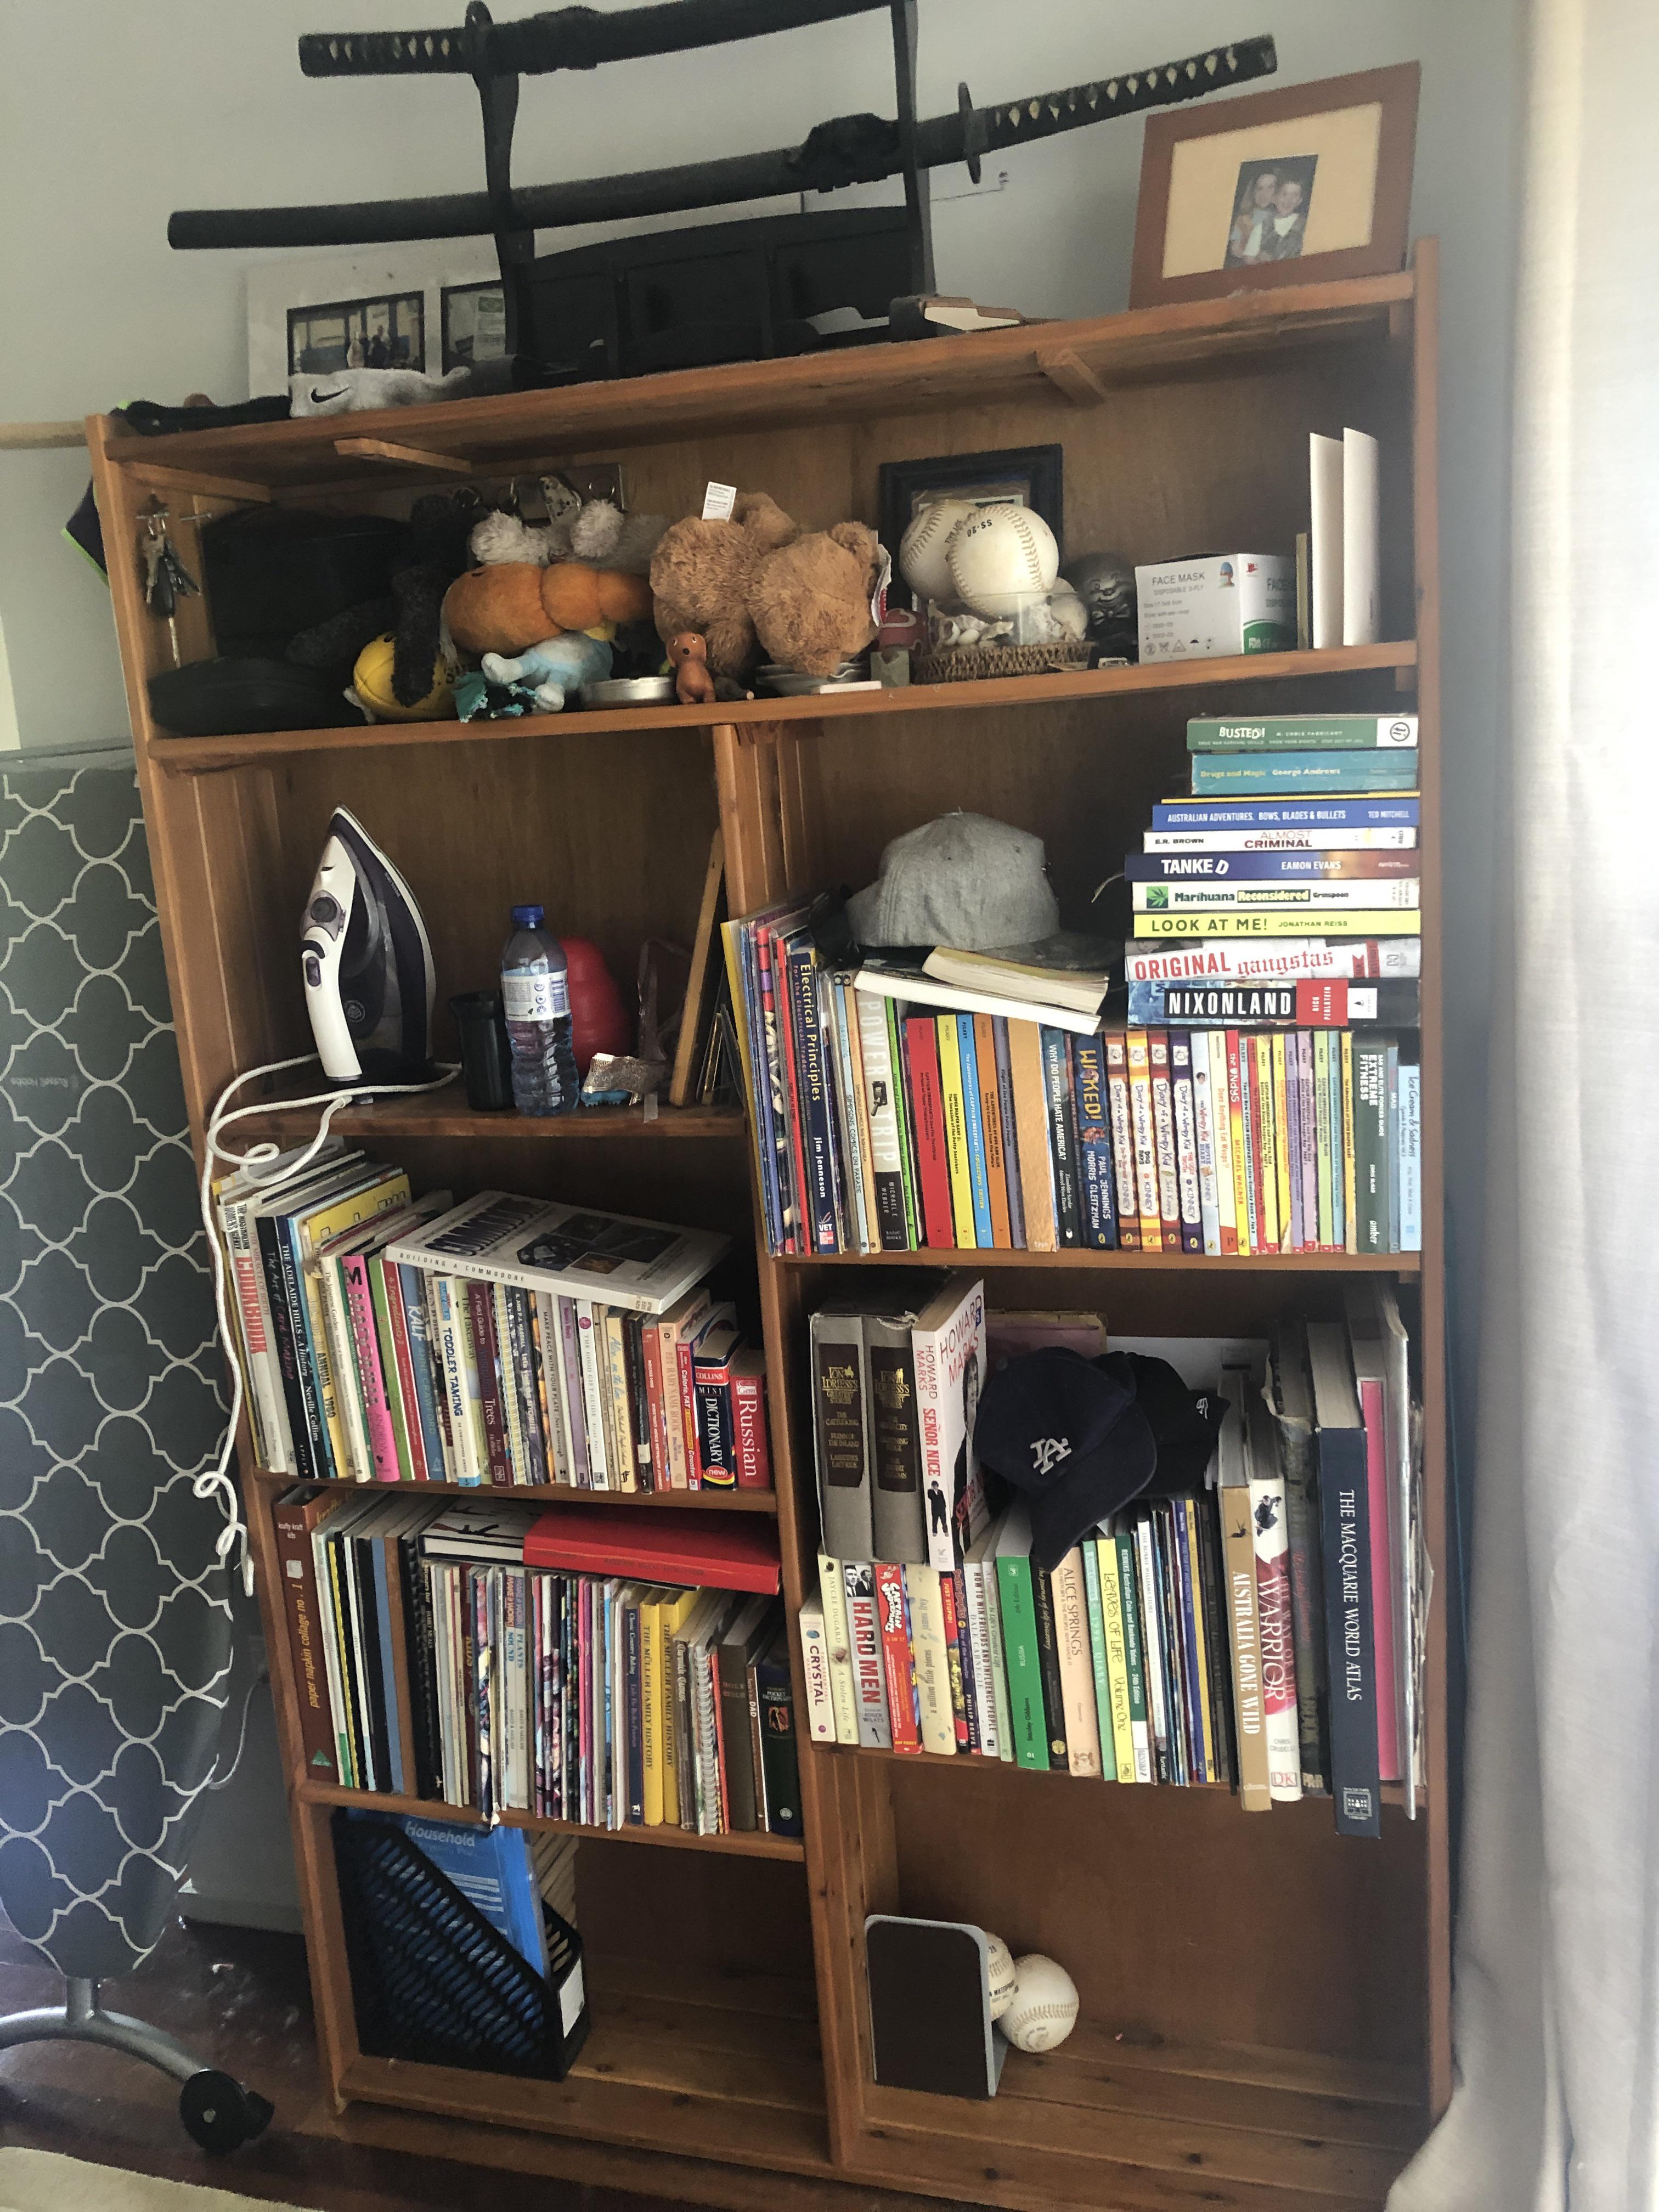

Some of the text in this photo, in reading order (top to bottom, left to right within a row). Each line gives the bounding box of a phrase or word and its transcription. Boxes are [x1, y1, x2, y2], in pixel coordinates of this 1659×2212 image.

[1153, 572, 1205, 585] FACE MASK
[1219, 726, 1265, 739] BUSTED!
[1244, 838, 1312, 849] CRIMINAL
[1260, 830, 1312, 840] ALMOST
[1282, 861, 1311, 870] EAMON
[1313, 860, 1341, 870] EVANS
[1175, 891, 1235, 902] Marihuana
[1238, 890, 1309, 901] Reconsidered
[1152, 919, 1200, 932] LOOK
[1207, 919, 1228, 931] AT
[1237, 919, 1267, 930] ME!
[1135, 952, 1231, 980] ORIGINAL
[1238, 950, 1334, 978] gangstas
[1169, 991, 1291, 1015] NIXONLAND
[800, 964, 826, 1198] Electrical Principles Jim Jenneson
[859, 1000, 896, 1163] POWER TRIP
[1359, 1054, 1368, 1100] FITNESS
[1368, 1054, 1377, 1106] EXTREME
[1048, 1044, 1065, 1160] WHY DO PEOPLE HATE AMERICA?
[1156, 1084, 1168, 1107] Diary
[1158, 1124, 1169, 1150] Wimpy
[1162, 1153, 1172, 1165] Kid
[1086, 1150, 1100, 1229] MORRIS GLEITZMAN
[1098, 1156, 1110, 1220] PAUL JENNINGS
[1369, 1221, 1380, 1244] amber
[282, 1244, 292, 1261] THE
[399, 1252, 445, 1267] BUILDING
[465, 1265, 525, 1282] COMMODORE
[285, 1263, 299, 1307] ADELAIDE
[237, 1256, 267, 1354] COOKBOOK
[265, 1251, 295, 1380] The Art of Card Making
[475, 1301, 483, 1316] Field
[292, 1308, 303, 1334] HILLS
[477, 1317, 486, 1336] Guide
[940, 1295, 983, 1364] HOWARD
[297, 1348, 309, 1376] History
[443, 1328, 462, 1417] TODDLER TAMING
[696, 1372, 723, 1380] COLLINS
[916, 1350, 927, 1390] MARKS
[924, 1345, 938, 1400] HOWARD
[317, 1352, 336, 1418] ANNUAL 1980
[680, 1369, 689, 1394] Calorie,
[699, 1386, 722, 1395] MINI
[304, 1385, 316, 1413] Neville
[484, 1398, 498, 1425] Trees
[309, 1414, 320, 1441] Collins
[705, 1397, 722, 1465] DICTIONARY
[738, 1399, 761, 1476] Russian
[923, 1407, 942, 1477] SEÑOR NICE
[1030, 1437, 1072, 1475] LA
[296, 1599, 305, 1611] no
[828, 1576, 838, 1605] JAYCEE
[918, 1598, 929, 1611] frey
[975, 1590, 983, 1599] TO
[1338, 1489, 1361, 1701] THE MACQUARIE WORLD ATLAS
[880, 1582, 896, 1633] UNDERPANTS
[889, 1581, 904, 1630] CAPTAIN
[1064, 1567, 1081, 1656] ALICE SPRINGS
[295, 1613, 311, 1646] collage
[832, 1608, 842, 1643] DUGARD
[919, 1612, 931, 1631] james
[978, 1617, 987, 1647] FRIENDS
[853, 1601, 881, 1704] HARD MEN
[1103, 1572, 1125, 1730] LEAVES OF LIFE Volume One
[1232, 1571, 1260, 1734] AUSTRALIA GONE WILD
[1257, 1576, 1286, 1701] WARRIOR
[300, 1647, 315, 1678] napkin
[644, 1647, 652, 1686] MÜLLER
[922, 1649, 934, 1668] pieces
[1018, 1645, 1026, 1666] RUSSIA
[809, 1645, 824, 1706] CRYSTAL
[924, 1669, 934, 1684] little
[983, 1664, 993, 1703] INFLUENCE
[306, 1680, 320, 1708] paper
[838, 1680, 848, 1702] Stolen
[926, 1686, 936, 1708] million
[840, 1706, 850, 1722] Life
[986, 1706, 995, 1731] PEOPLE
[405, 1821, 475, 1847] Household
